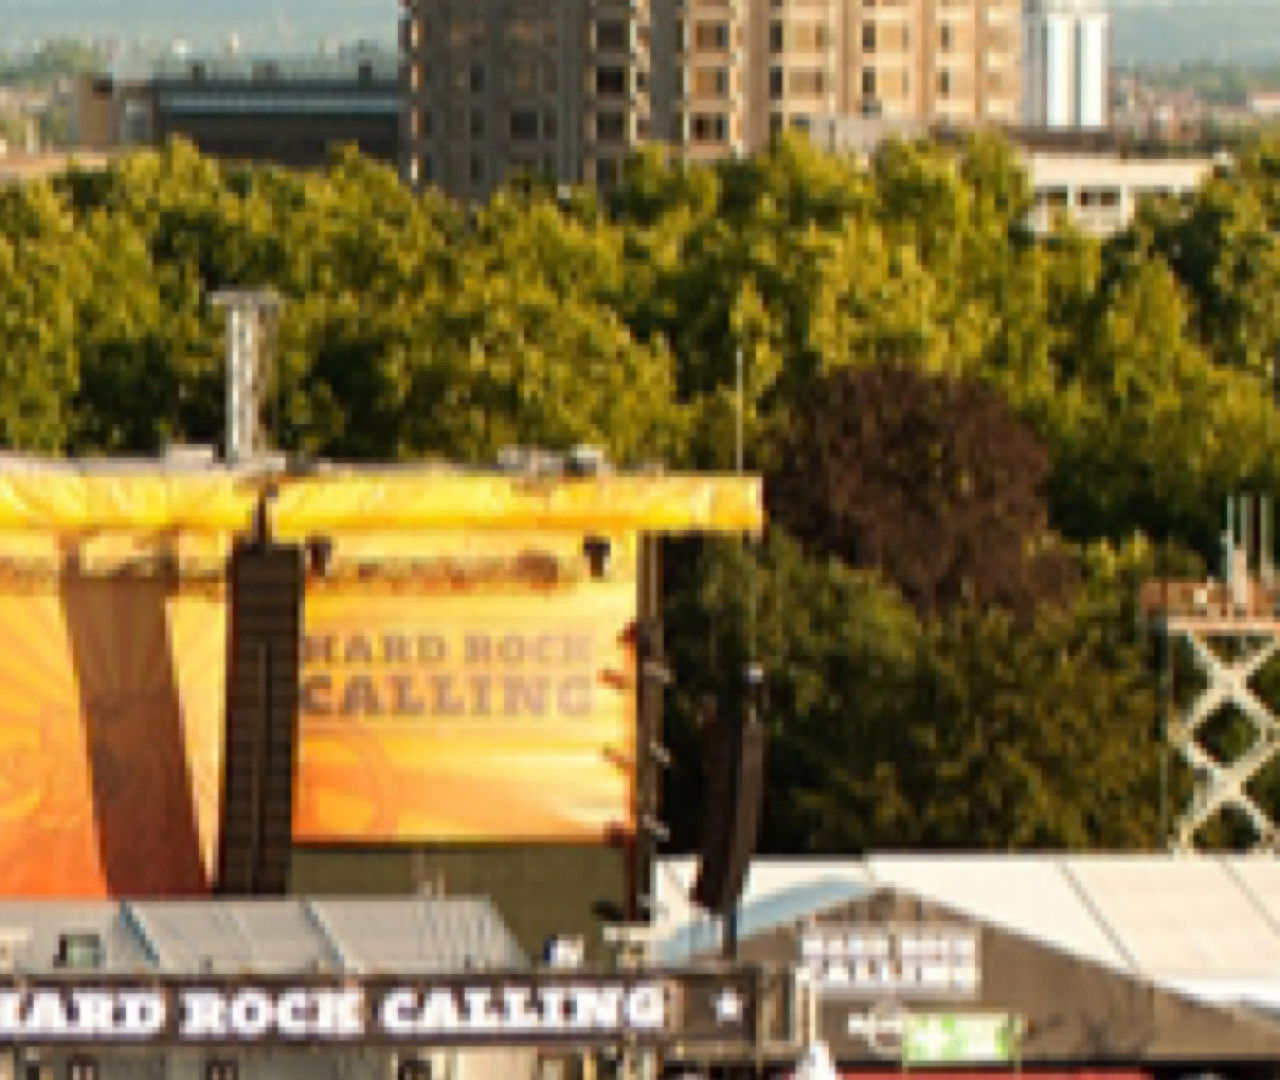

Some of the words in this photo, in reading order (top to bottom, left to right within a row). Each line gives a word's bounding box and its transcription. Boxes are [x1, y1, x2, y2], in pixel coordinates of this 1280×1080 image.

[302, 630, 451, 666] HARD
[462, 630, 595, 666] ROCK
[302, 673, 595, 718] CALLING
[178, 986, 366, 1037] ROCK
[378, 983, 666, 1034] CALLING
